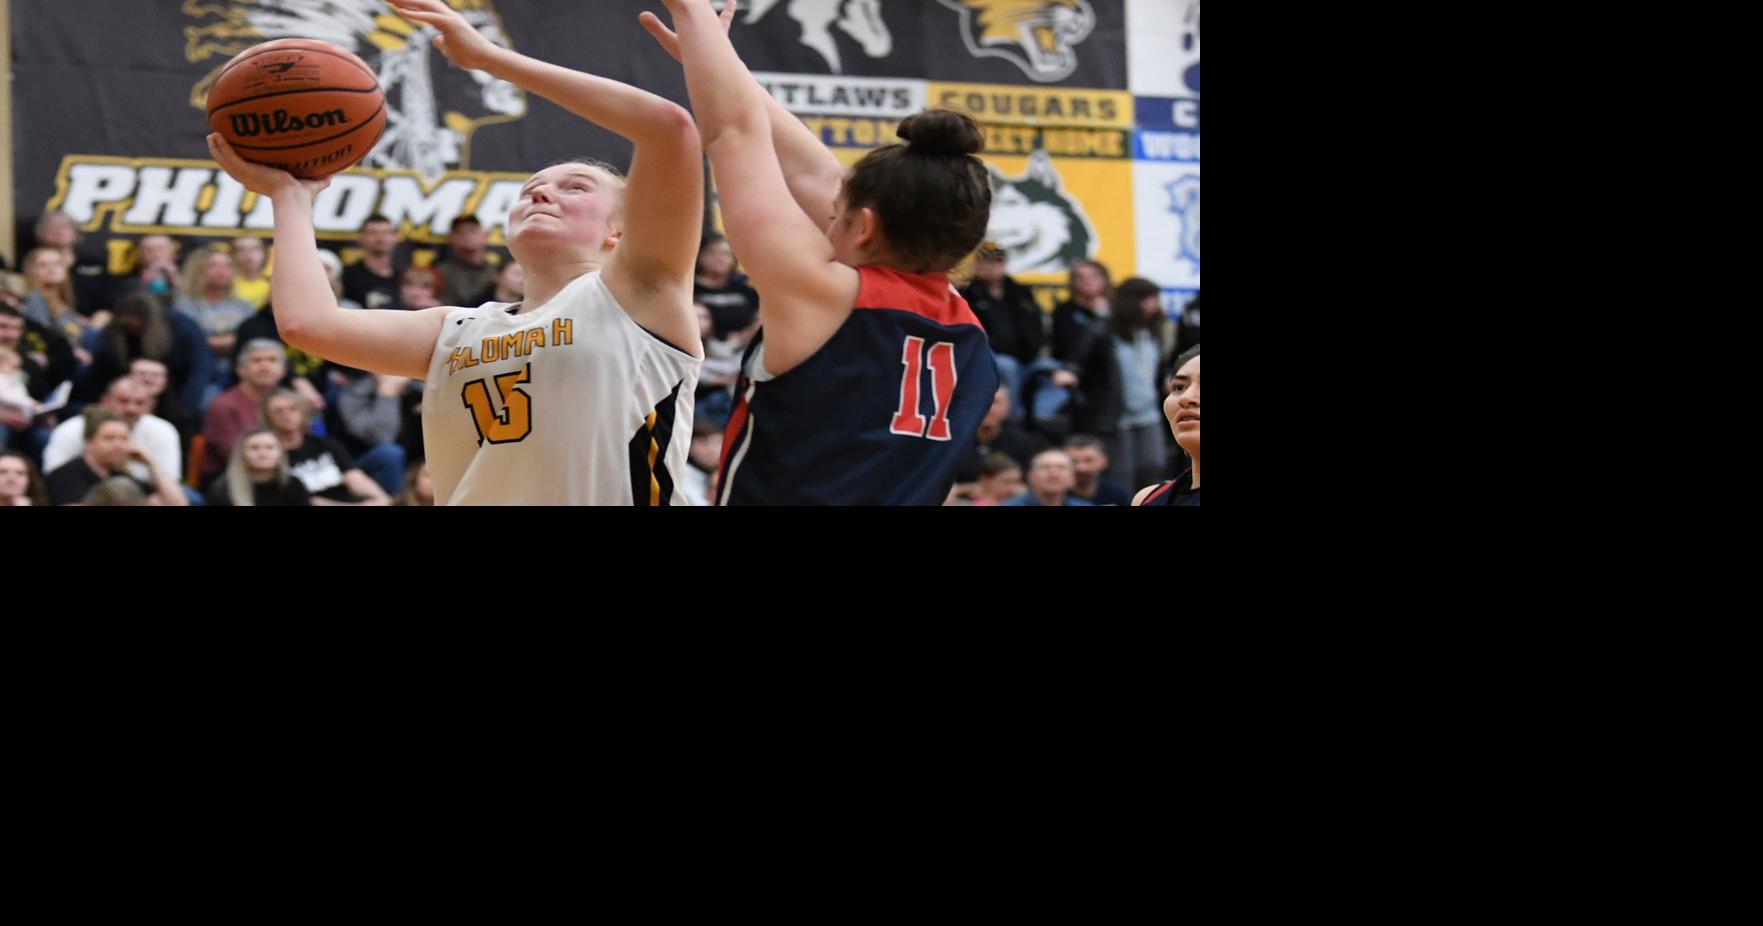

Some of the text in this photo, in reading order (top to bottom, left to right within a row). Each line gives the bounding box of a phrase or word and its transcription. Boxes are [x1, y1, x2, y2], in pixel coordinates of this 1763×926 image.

[766, 83, 911, 108] TLAWS
[940, 90, 1117, 121] COUGARS
[229, 109, 347, 136] Wilson
[889, 335, 958, 442] 11
[461, 362, 532, 448] 15
